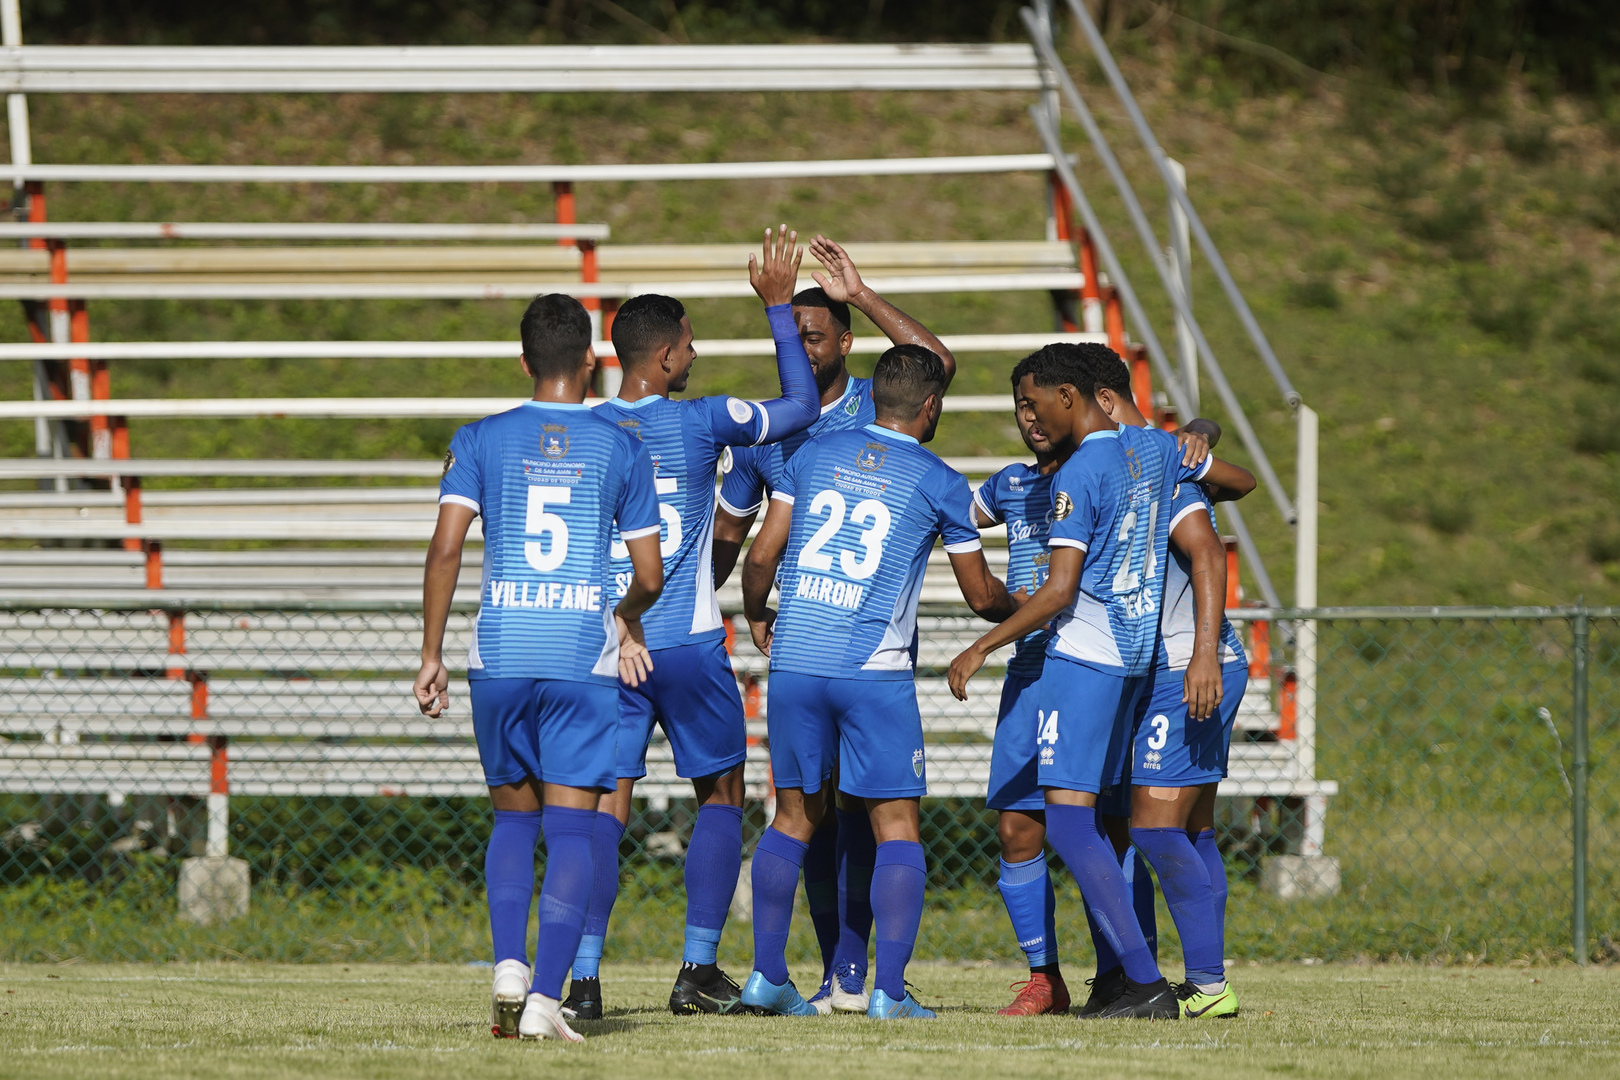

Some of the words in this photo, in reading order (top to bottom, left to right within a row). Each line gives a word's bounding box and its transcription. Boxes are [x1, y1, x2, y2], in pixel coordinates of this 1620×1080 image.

[524, 484, 572, 572] 5
[797, 489, 891, 580] 23
[1010, 519, 1040, 545] San
[490, 579, 601, 611] VILLAFAÑE
[796, 574, 864, 609] MARONI
[1147, 714, 1169, 750] 3
